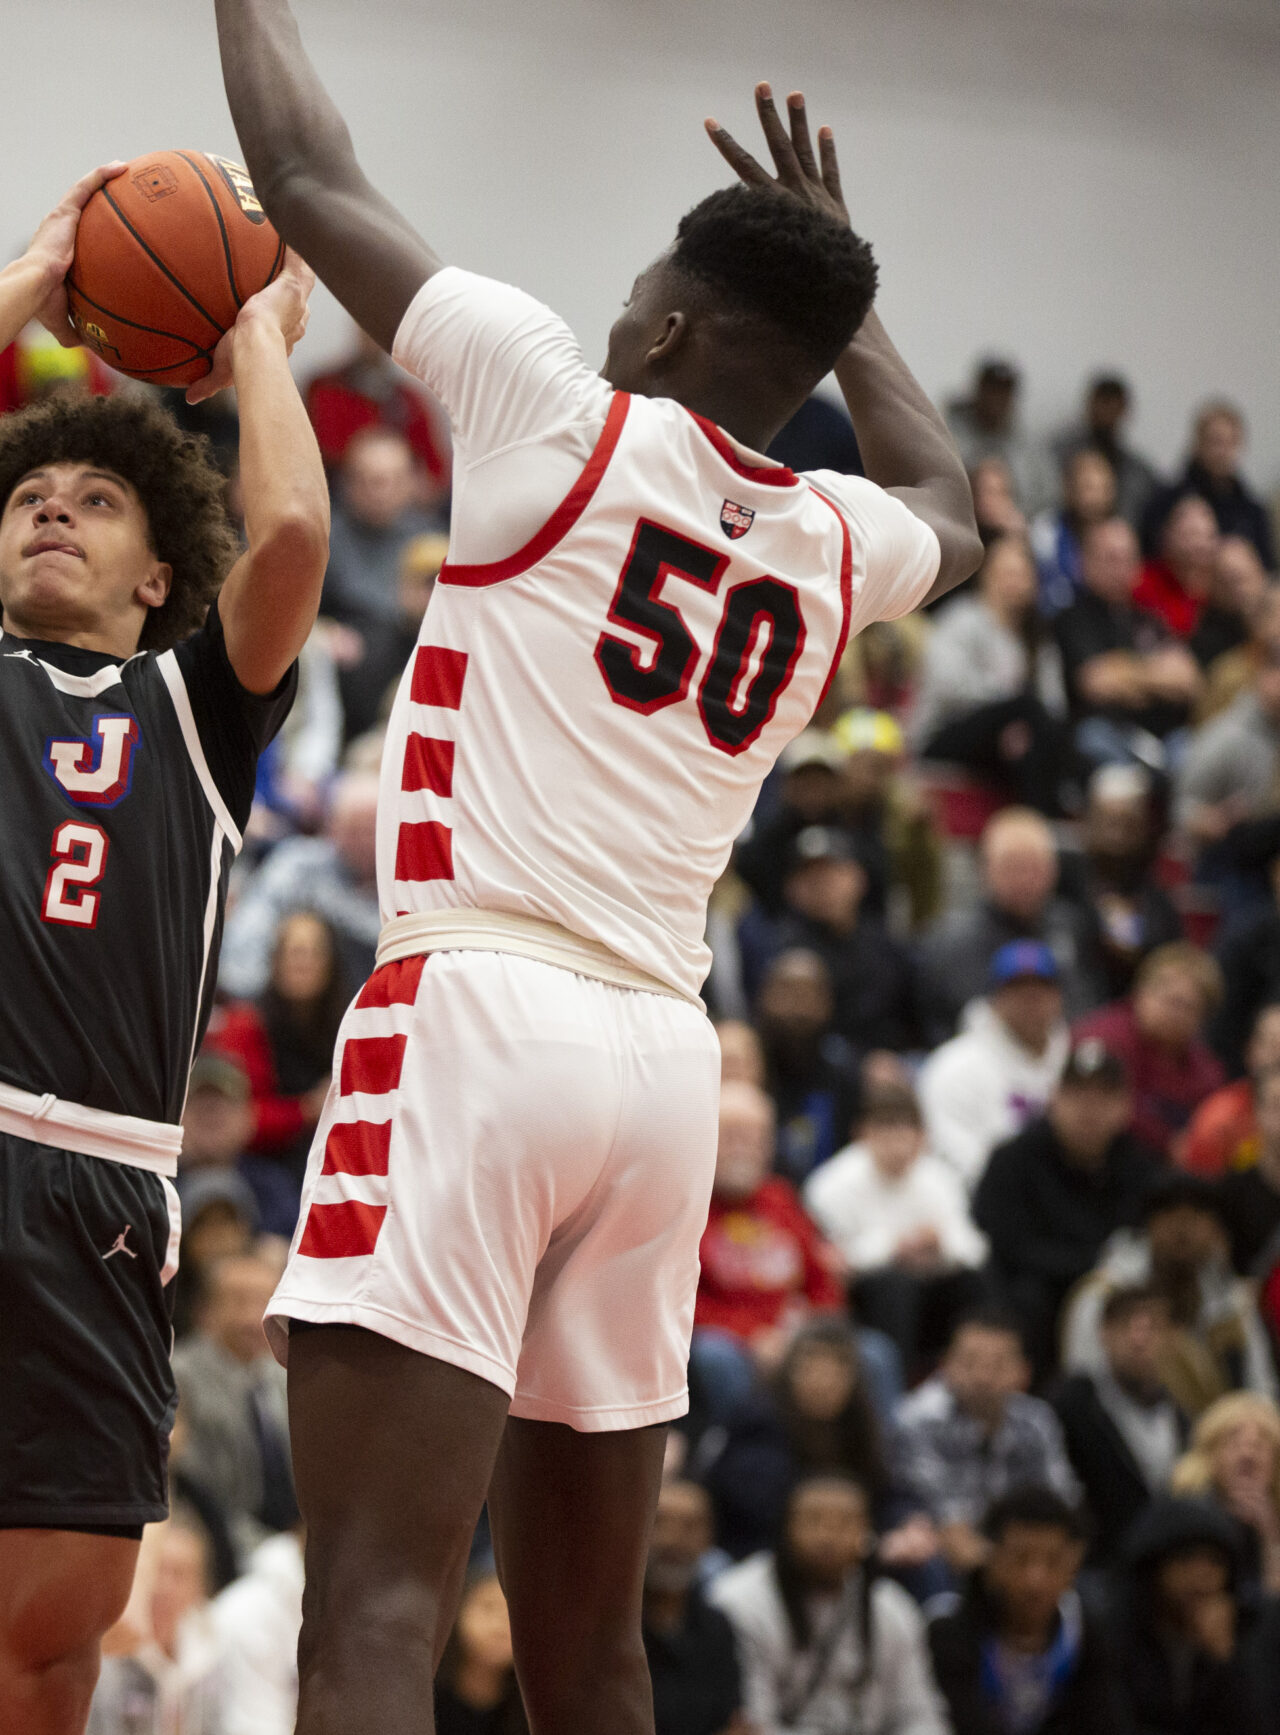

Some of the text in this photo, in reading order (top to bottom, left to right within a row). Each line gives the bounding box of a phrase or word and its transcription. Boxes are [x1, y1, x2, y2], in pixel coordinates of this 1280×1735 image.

[593, 516, 808, 758] 50
[41, 712, 144, 809] J
[40, 818, 110, 930] 2
